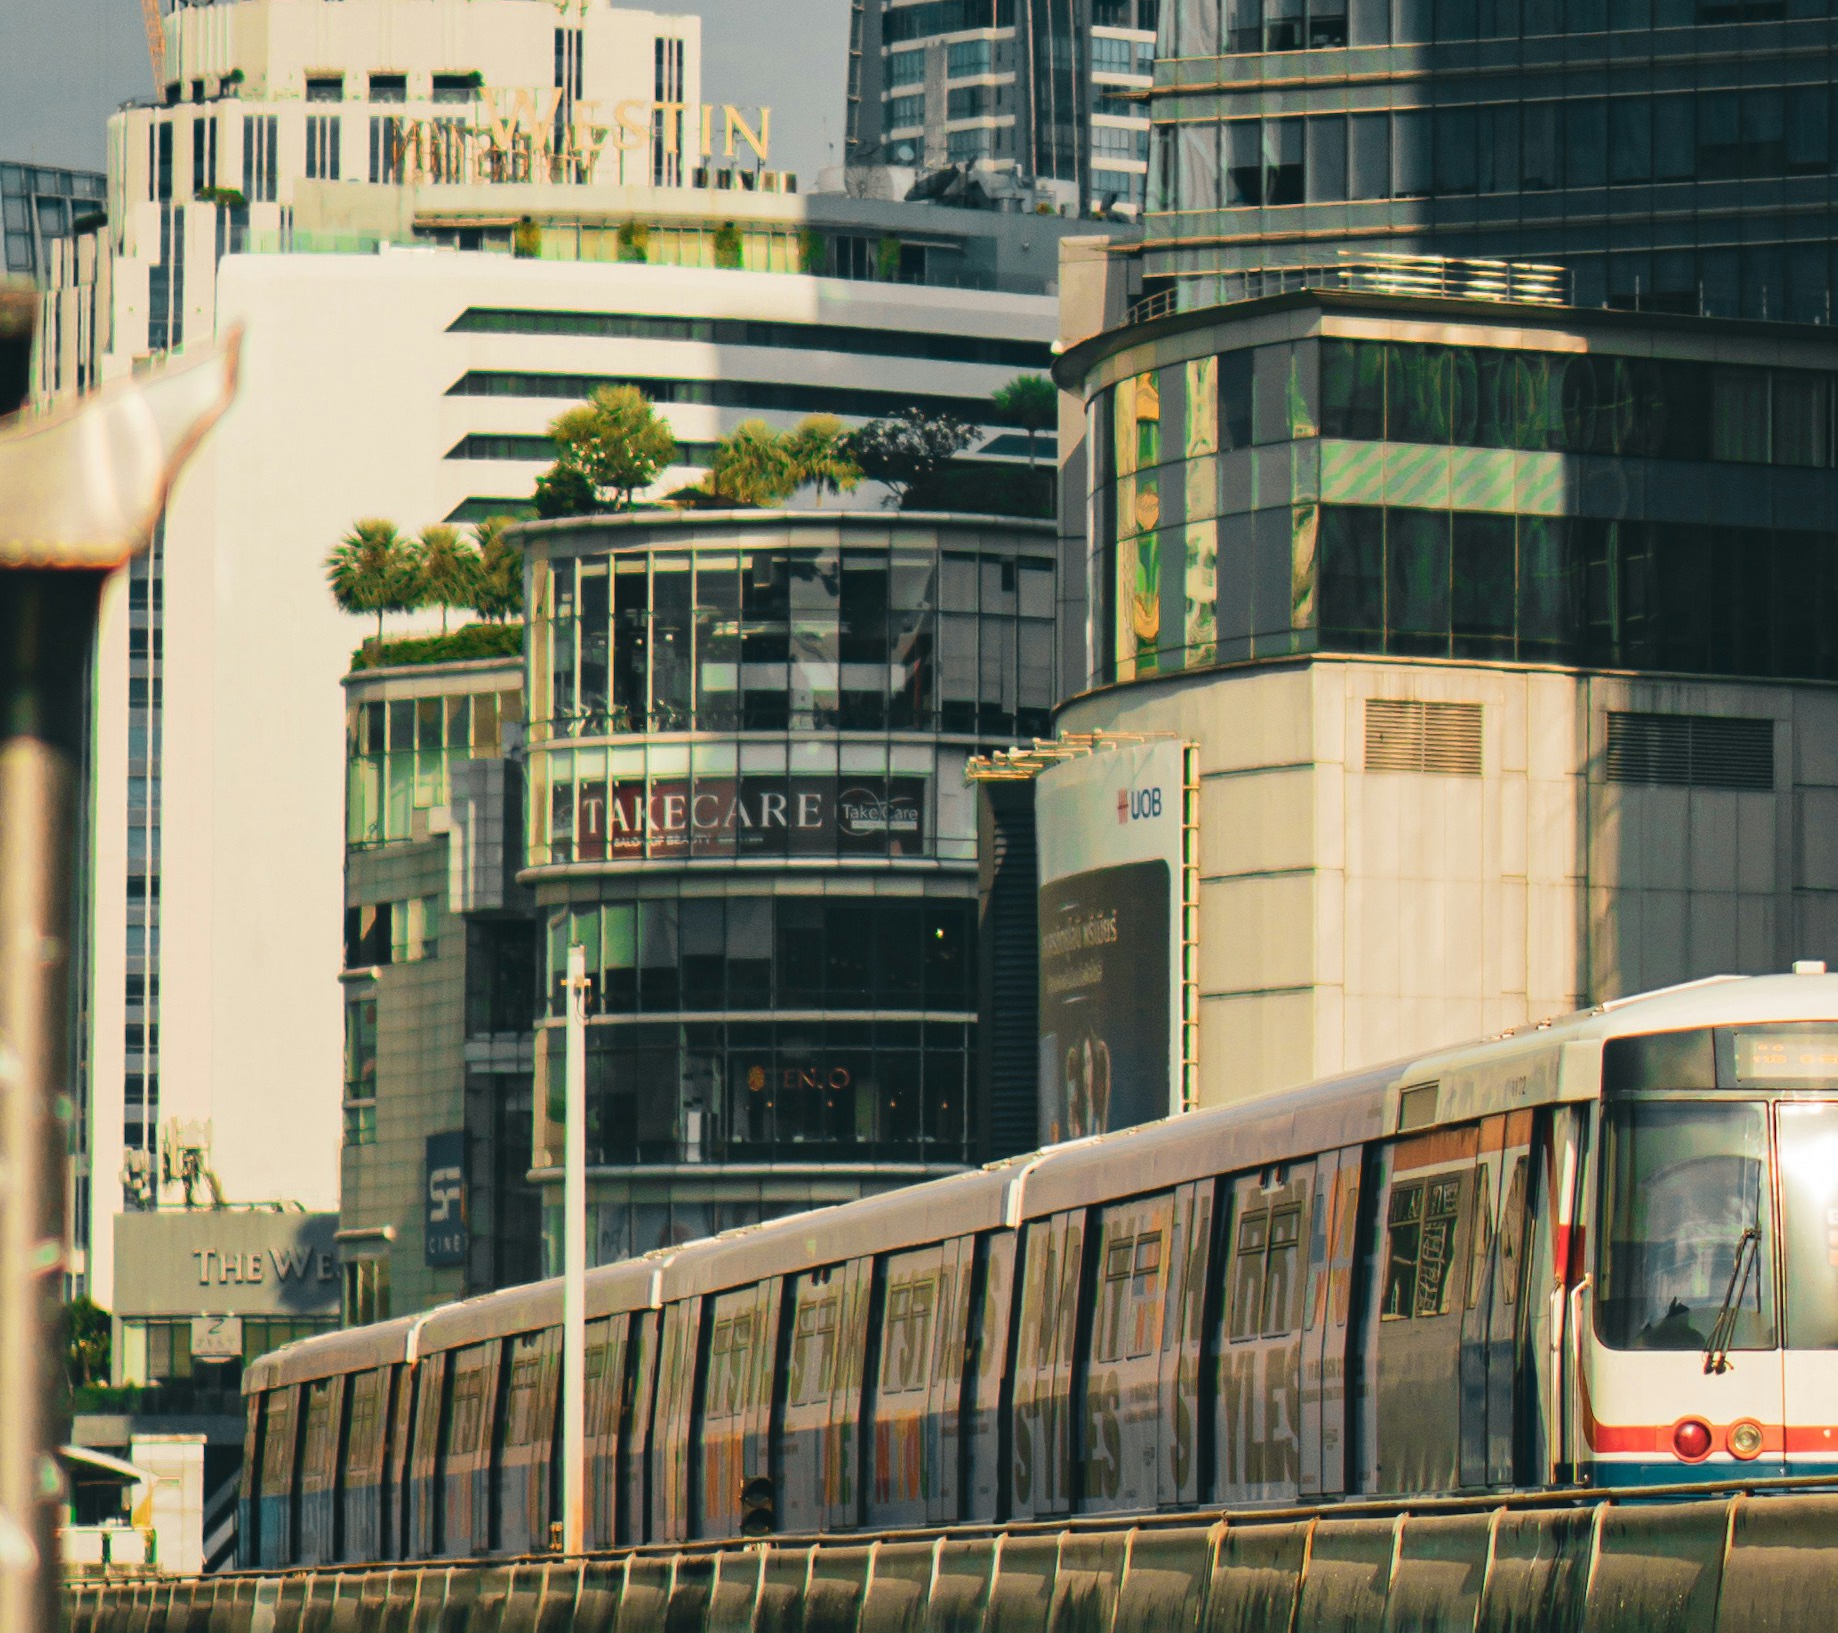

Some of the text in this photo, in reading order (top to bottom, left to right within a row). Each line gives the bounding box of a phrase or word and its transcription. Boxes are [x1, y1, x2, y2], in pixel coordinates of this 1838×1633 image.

[478, 87, 770, 159] WESTIN
[842, 804, 877, 820] Take
[1130, 787, 1162, 820] UOB
[429, 1233, 460, 1254] CINE
[193, 1246, 340, 1284] THE WE
